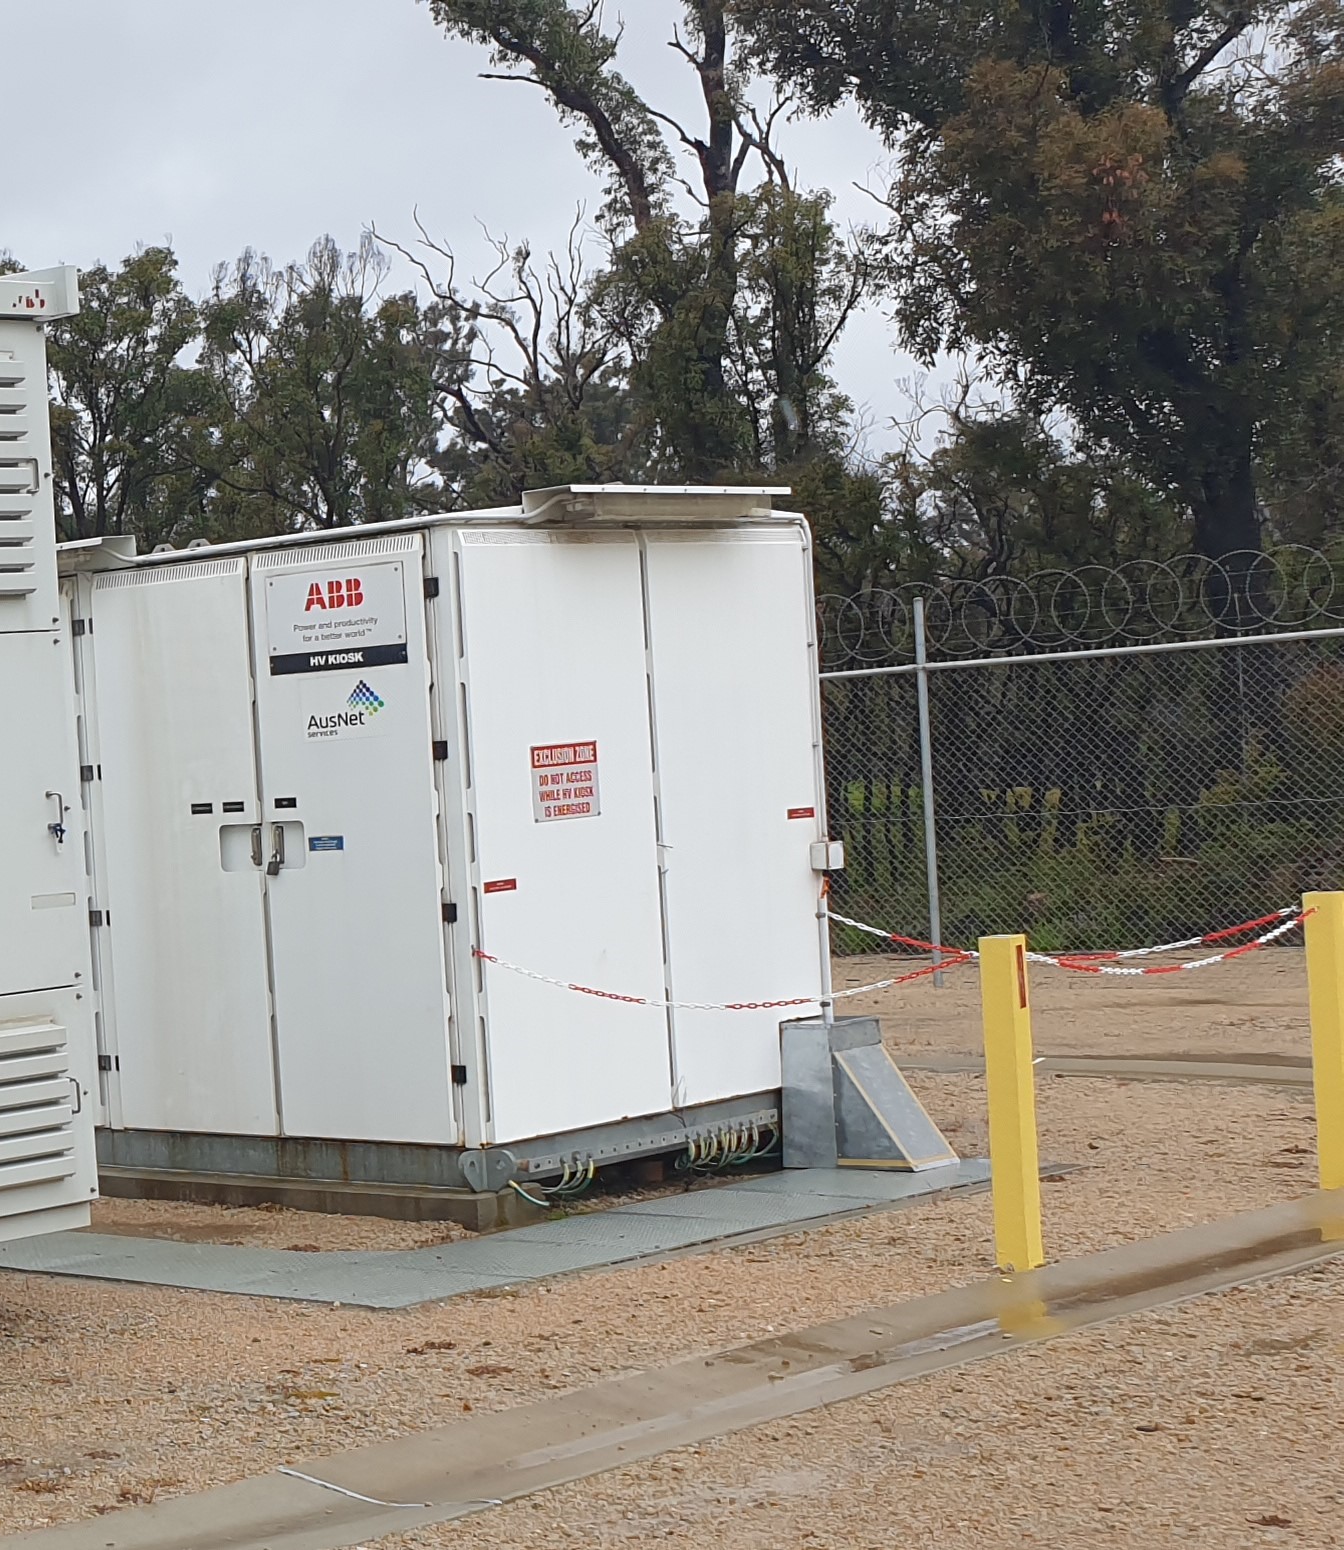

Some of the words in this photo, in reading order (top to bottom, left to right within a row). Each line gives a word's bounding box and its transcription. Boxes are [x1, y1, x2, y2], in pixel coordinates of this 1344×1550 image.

[304, 578, 365, 612] ABB
[293, 624, 317, 632] Power
[318, 620, 333, 630] and
[334, 617, 378, 630] productivity
[303, 634, 313, 643] for
[321, 632, 342, 641] better
[310, 656, 326, 667] HV
[328, 652, 364, 664] KIOSK
[307, 711, 365, 730] AusNet
[307, 730, 338, 738] services
[534, 747, 574, 766] EXCLUSION
[539, 774, 549, 786] DO
[566, 770, 592, 783] ACCESS
[539, 789, 561, 802] WHILE
